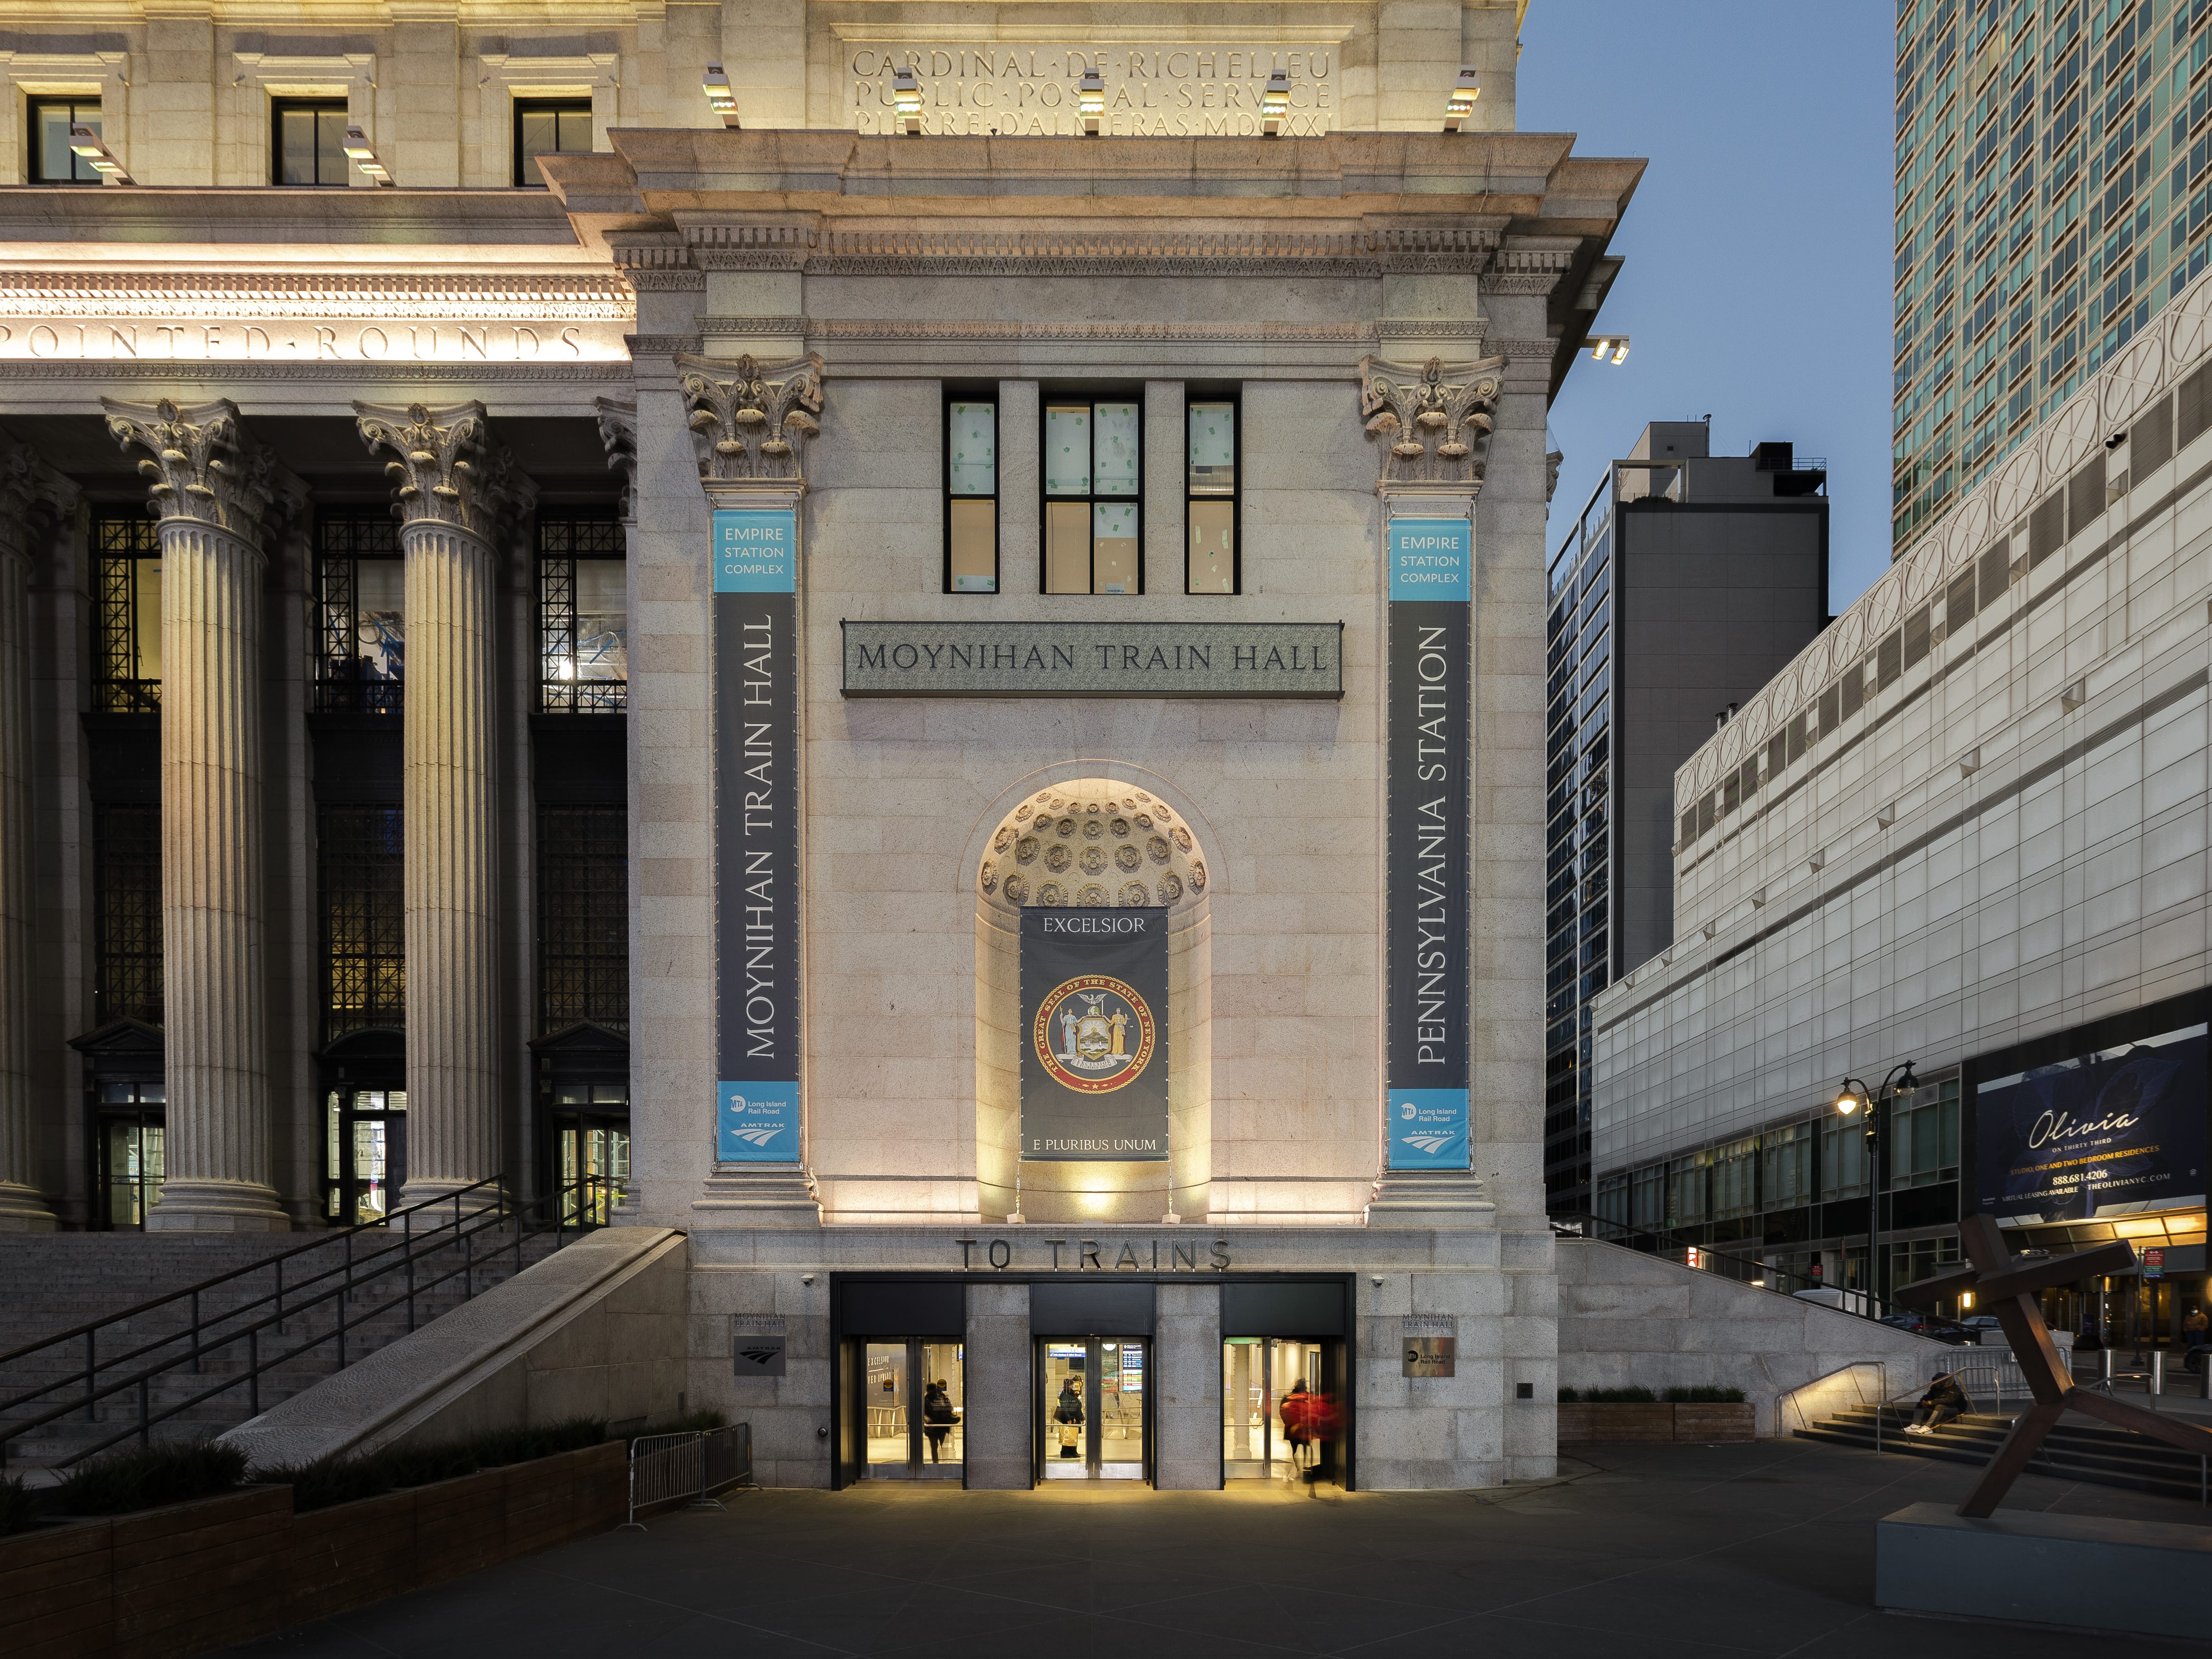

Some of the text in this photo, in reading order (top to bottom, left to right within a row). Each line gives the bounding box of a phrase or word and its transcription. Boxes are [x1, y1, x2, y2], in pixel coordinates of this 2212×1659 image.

[852, 50, 1329, 78] CARDINAL DE RICHELIEU
[1018, 82, 1157, 107] POSAL
[1177, 83, 1329, 108] SERVCE
[1203, 112, 1334, 137] MDXXI
[315, 325, 581, 359] ROUNDS
[726, 528, 783, 540] EMPIRE
[1401, 536, 1459, 549] EMPIRE
[725, 547, 784, 558] STATION
[1401, 556, 1459, 566] STATION
[725, 565, 784, 574] COMPLEX
[1401, 573, 1459, 583] COMPLEX
[858, 643, 1327, 670] MOYNIHAN TRAIN HALL
[743, 614, 775, 1059] MOYNIHAN TRAIN HALL
[1418, 626, 1447, 1065] PENNSYLVANIA STATION
[1044, 917, 1146, 933] EXCELSIOR
[1066, 981, 1080, 990] OF
[1109, 982, 1138, 1004] STATE
[1044, 990, 1065, 1012] SEAL
[1138, 1005, 1147, 1017] OF
[1039, 1015, 1047, 1049] GREAT
[1043, 1053, 1058, 1072] THE
[1131, 1044, 1150, 1072] YORK
[730, 1098, 744, 1109] MTA
[1401, 1106, 1414, 1117] MTA
[2029, 1110, 2139, 1149] Olivia
[1033, 1140, 1156, 1151] E PLURIBUS UNUM
[2064, 1142, 2088, 1151] THIRTY
[2090, 1138, 2111, 1146] THIRD
[2011, 1167, 2034, 1175] STUDIO,
[2079, 1152, 2114, 1164] BEDROOM
[2115, 1145, 2160, 1158] RESIDENCES
[2053, 1169, 2108, 1185] 888.681.4206
[2087, 1173, 2171, 1190] THEOLIVIANYC.COM
[2025, 1190, 2048, 1199] LEASING
[2048, 1186, 2079, 1195] AVAILABLE
[955, 1239, 1231, 1269] TO TRAINS
